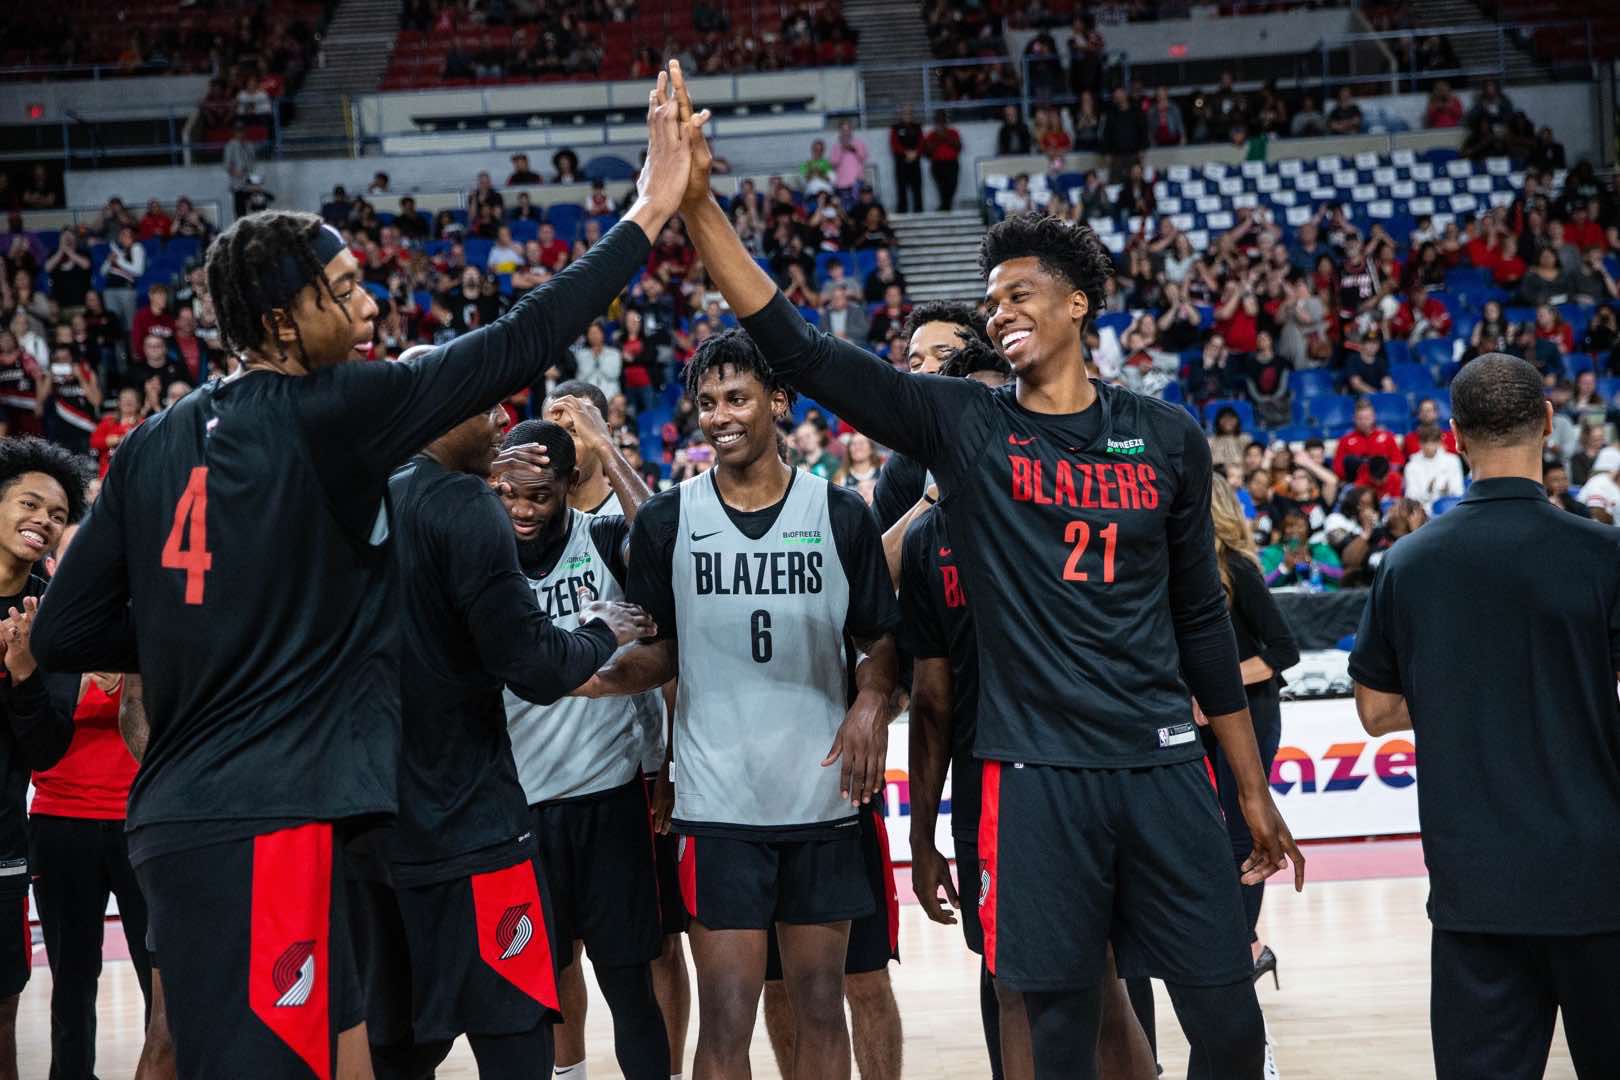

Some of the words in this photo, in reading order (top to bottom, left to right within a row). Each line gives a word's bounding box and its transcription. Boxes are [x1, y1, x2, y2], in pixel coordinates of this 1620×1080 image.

[1008, 455, 1159, 510] BLAZERS
[161, 466, 212, 605] 4
[1062, 520, 1118, 583] 21
[690, 551, 823, 595] BLAZERS
[750, 609, 773, 663] 6
